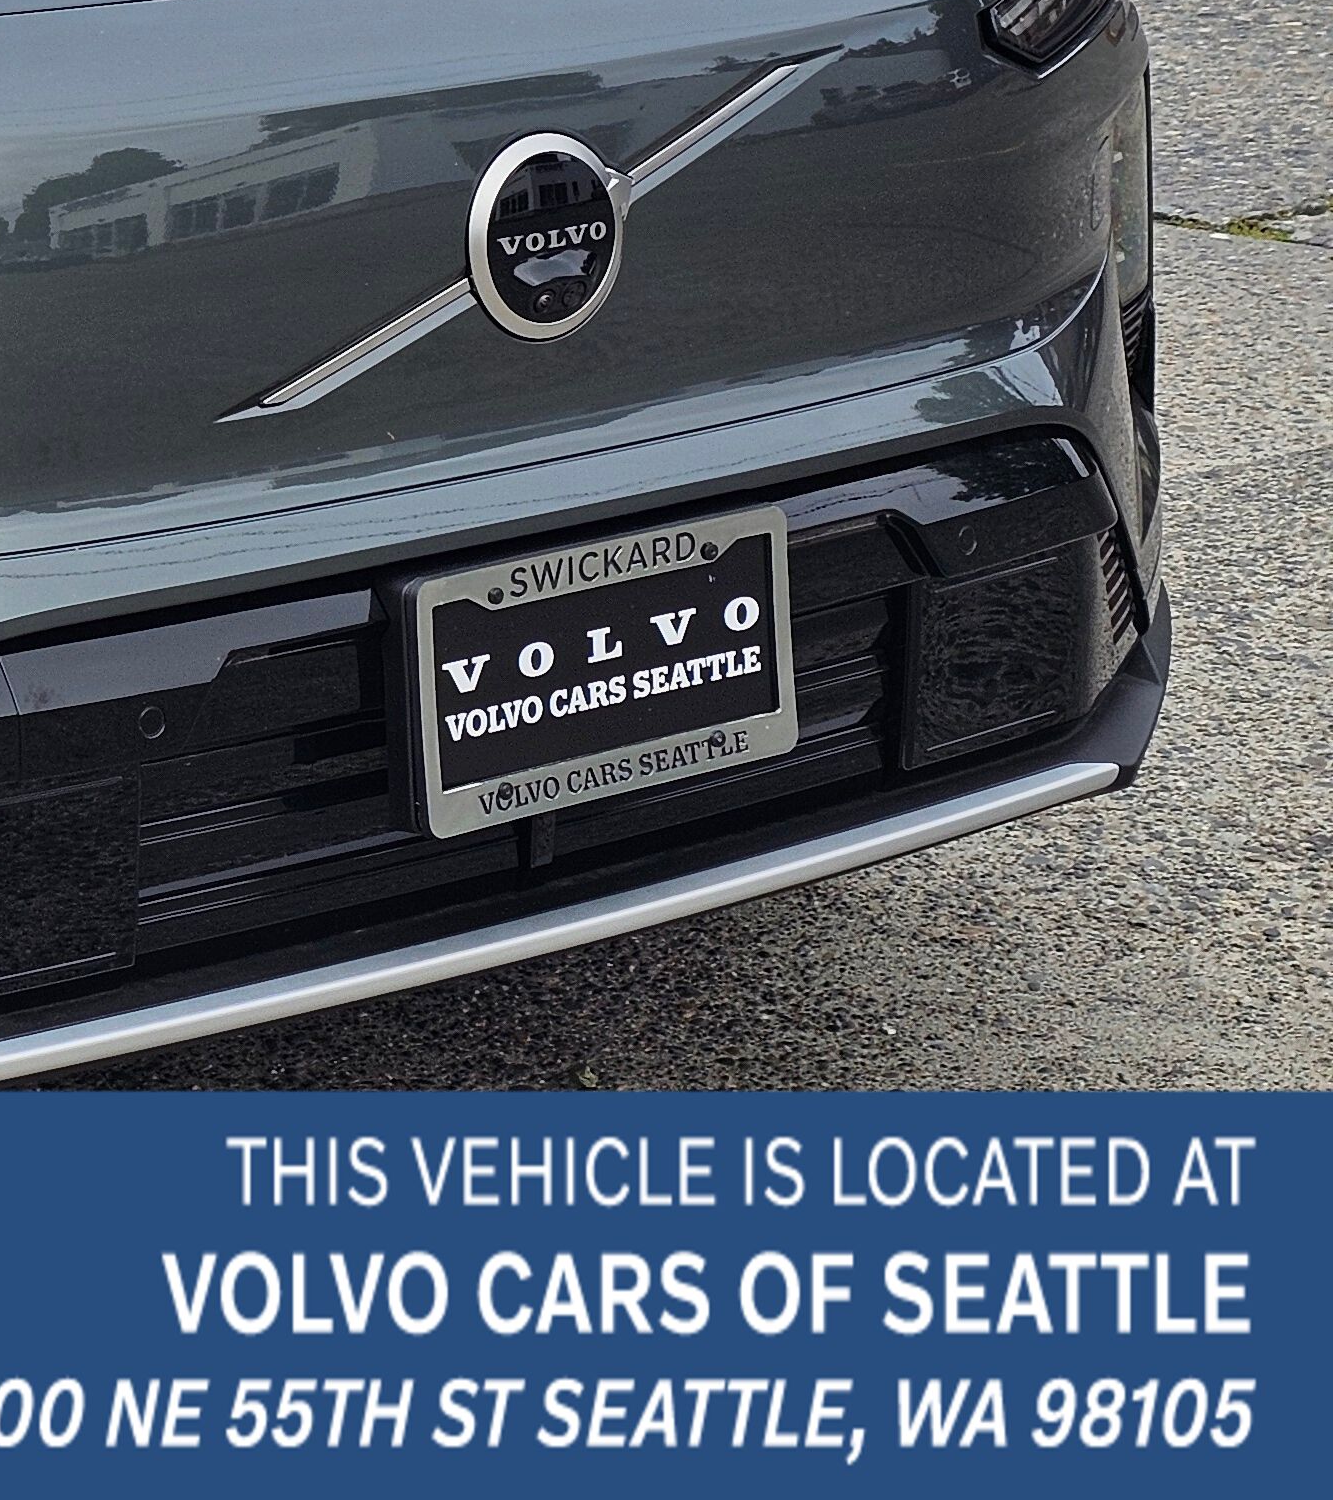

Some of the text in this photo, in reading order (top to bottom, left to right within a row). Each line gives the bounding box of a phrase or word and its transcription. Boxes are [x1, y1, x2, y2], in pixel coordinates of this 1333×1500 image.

[497, 221, 607, 255] VOLVO
[509, 532, 696, 598] SWICKARD
[442, 596, 760, 694] VOLVO
[445, 646, 762, 742] VOLVO CARS SEATTLE
[567, 758, 633, 798] CARS
